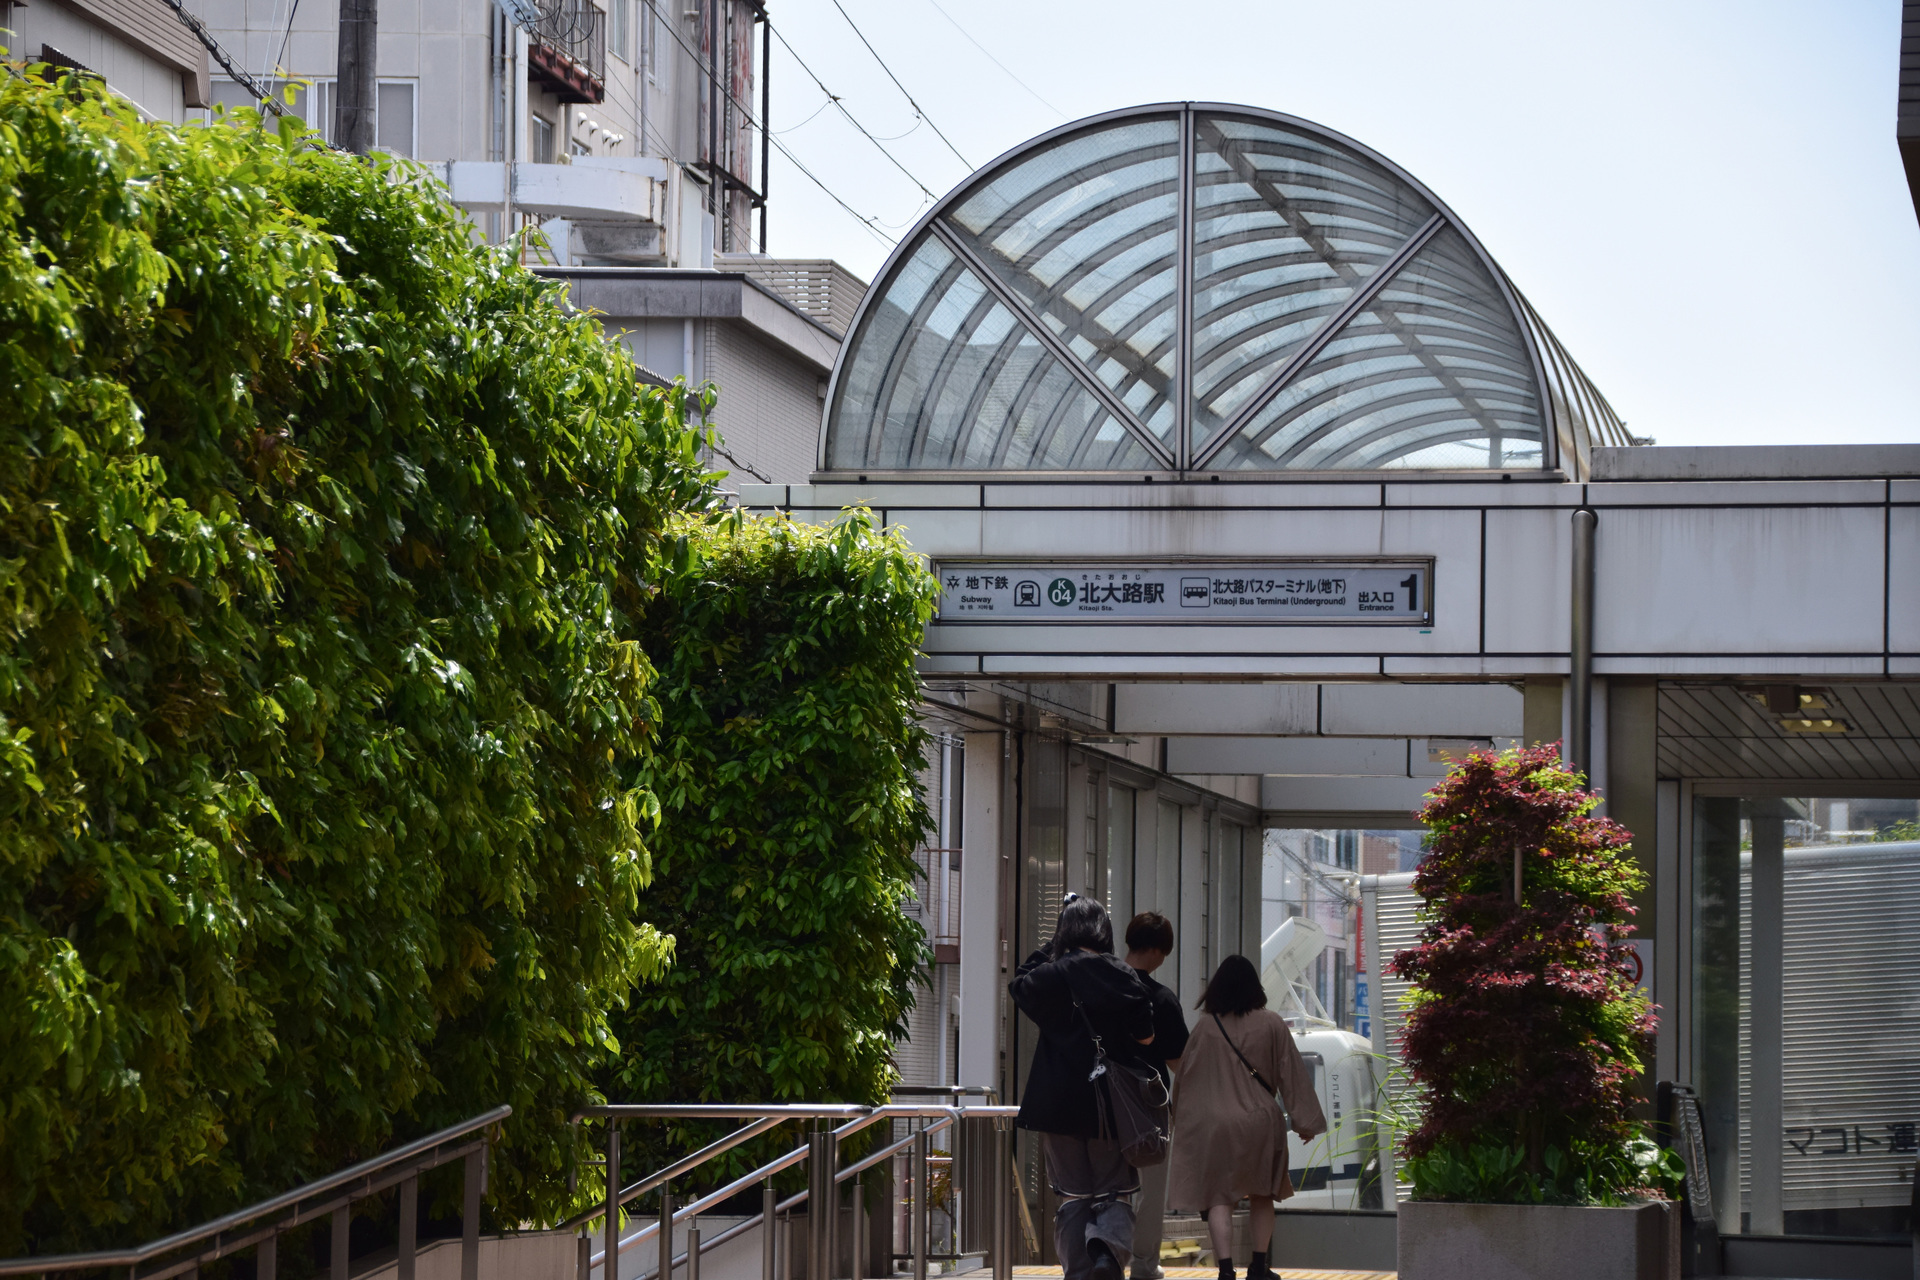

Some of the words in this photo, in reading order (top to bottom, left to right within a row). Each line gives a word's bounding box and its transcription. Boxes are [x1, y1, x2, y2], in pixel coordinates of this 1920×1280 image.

[965, 576, 1009, 590] 地下鉄
[1057, 580, 1067, 590] K
[1212, 579, 1347, 594] 北大路バスターミナル(地下)
[1051, 589, 1072, 603] 04
[1079, 582, 1165, 604] 北大路駅
[1358, 591, 1394, 603] 出入口
[1400, 574, 1418, 611] 1
[961, 595, 992, 604] Subway
[1213, 597, 1237, 607] Kitaoji
[1239, 597, 1255, 605] Bus
[1256, 597, 1289, 605] Terminal
[1290, 597, 1346, 607] (Underground)
[1358, 603, 1394, 612] Entrance
